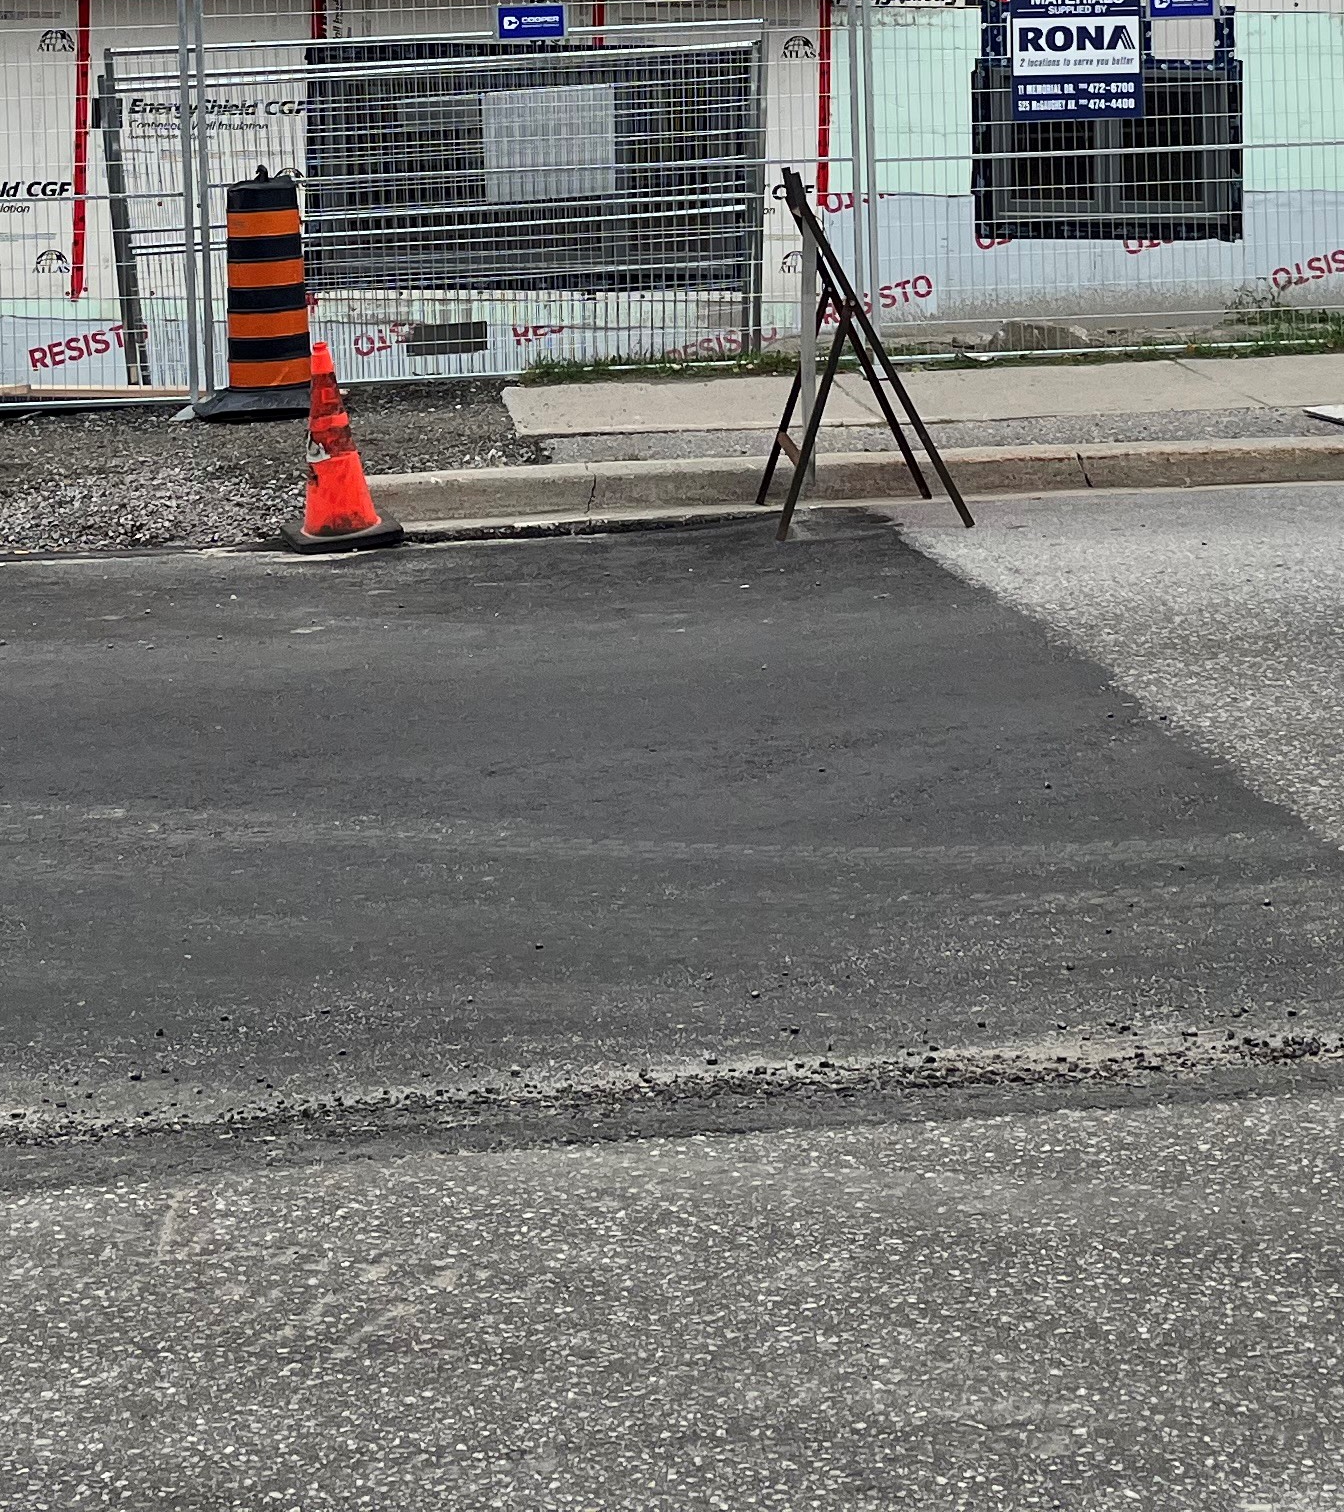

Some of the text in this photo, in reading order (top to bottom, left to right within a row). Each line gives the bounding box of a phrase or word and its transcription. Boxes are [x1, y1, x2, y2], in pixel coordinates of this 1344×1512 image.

[1047, 5, 1107, 14] SUPPLIED BY
[1018, 25, 1136, 52] RONA
[37, 44, 75, 53] ATLAS
[780, 50, 816, 59] ATLAS
[1019, 58, 1025, 67] 2
[1027, 58, 1060, 68] locations
[1063, 57, 1070, 67] to
[1096, 59, 1109, 68] you
[1111, 57, 1135, 66] better
[1088, 98, 1136, 109] 474-4400
[27, 181, 72, 198] CGF
[32, 265, 71, 274] ATLAS
